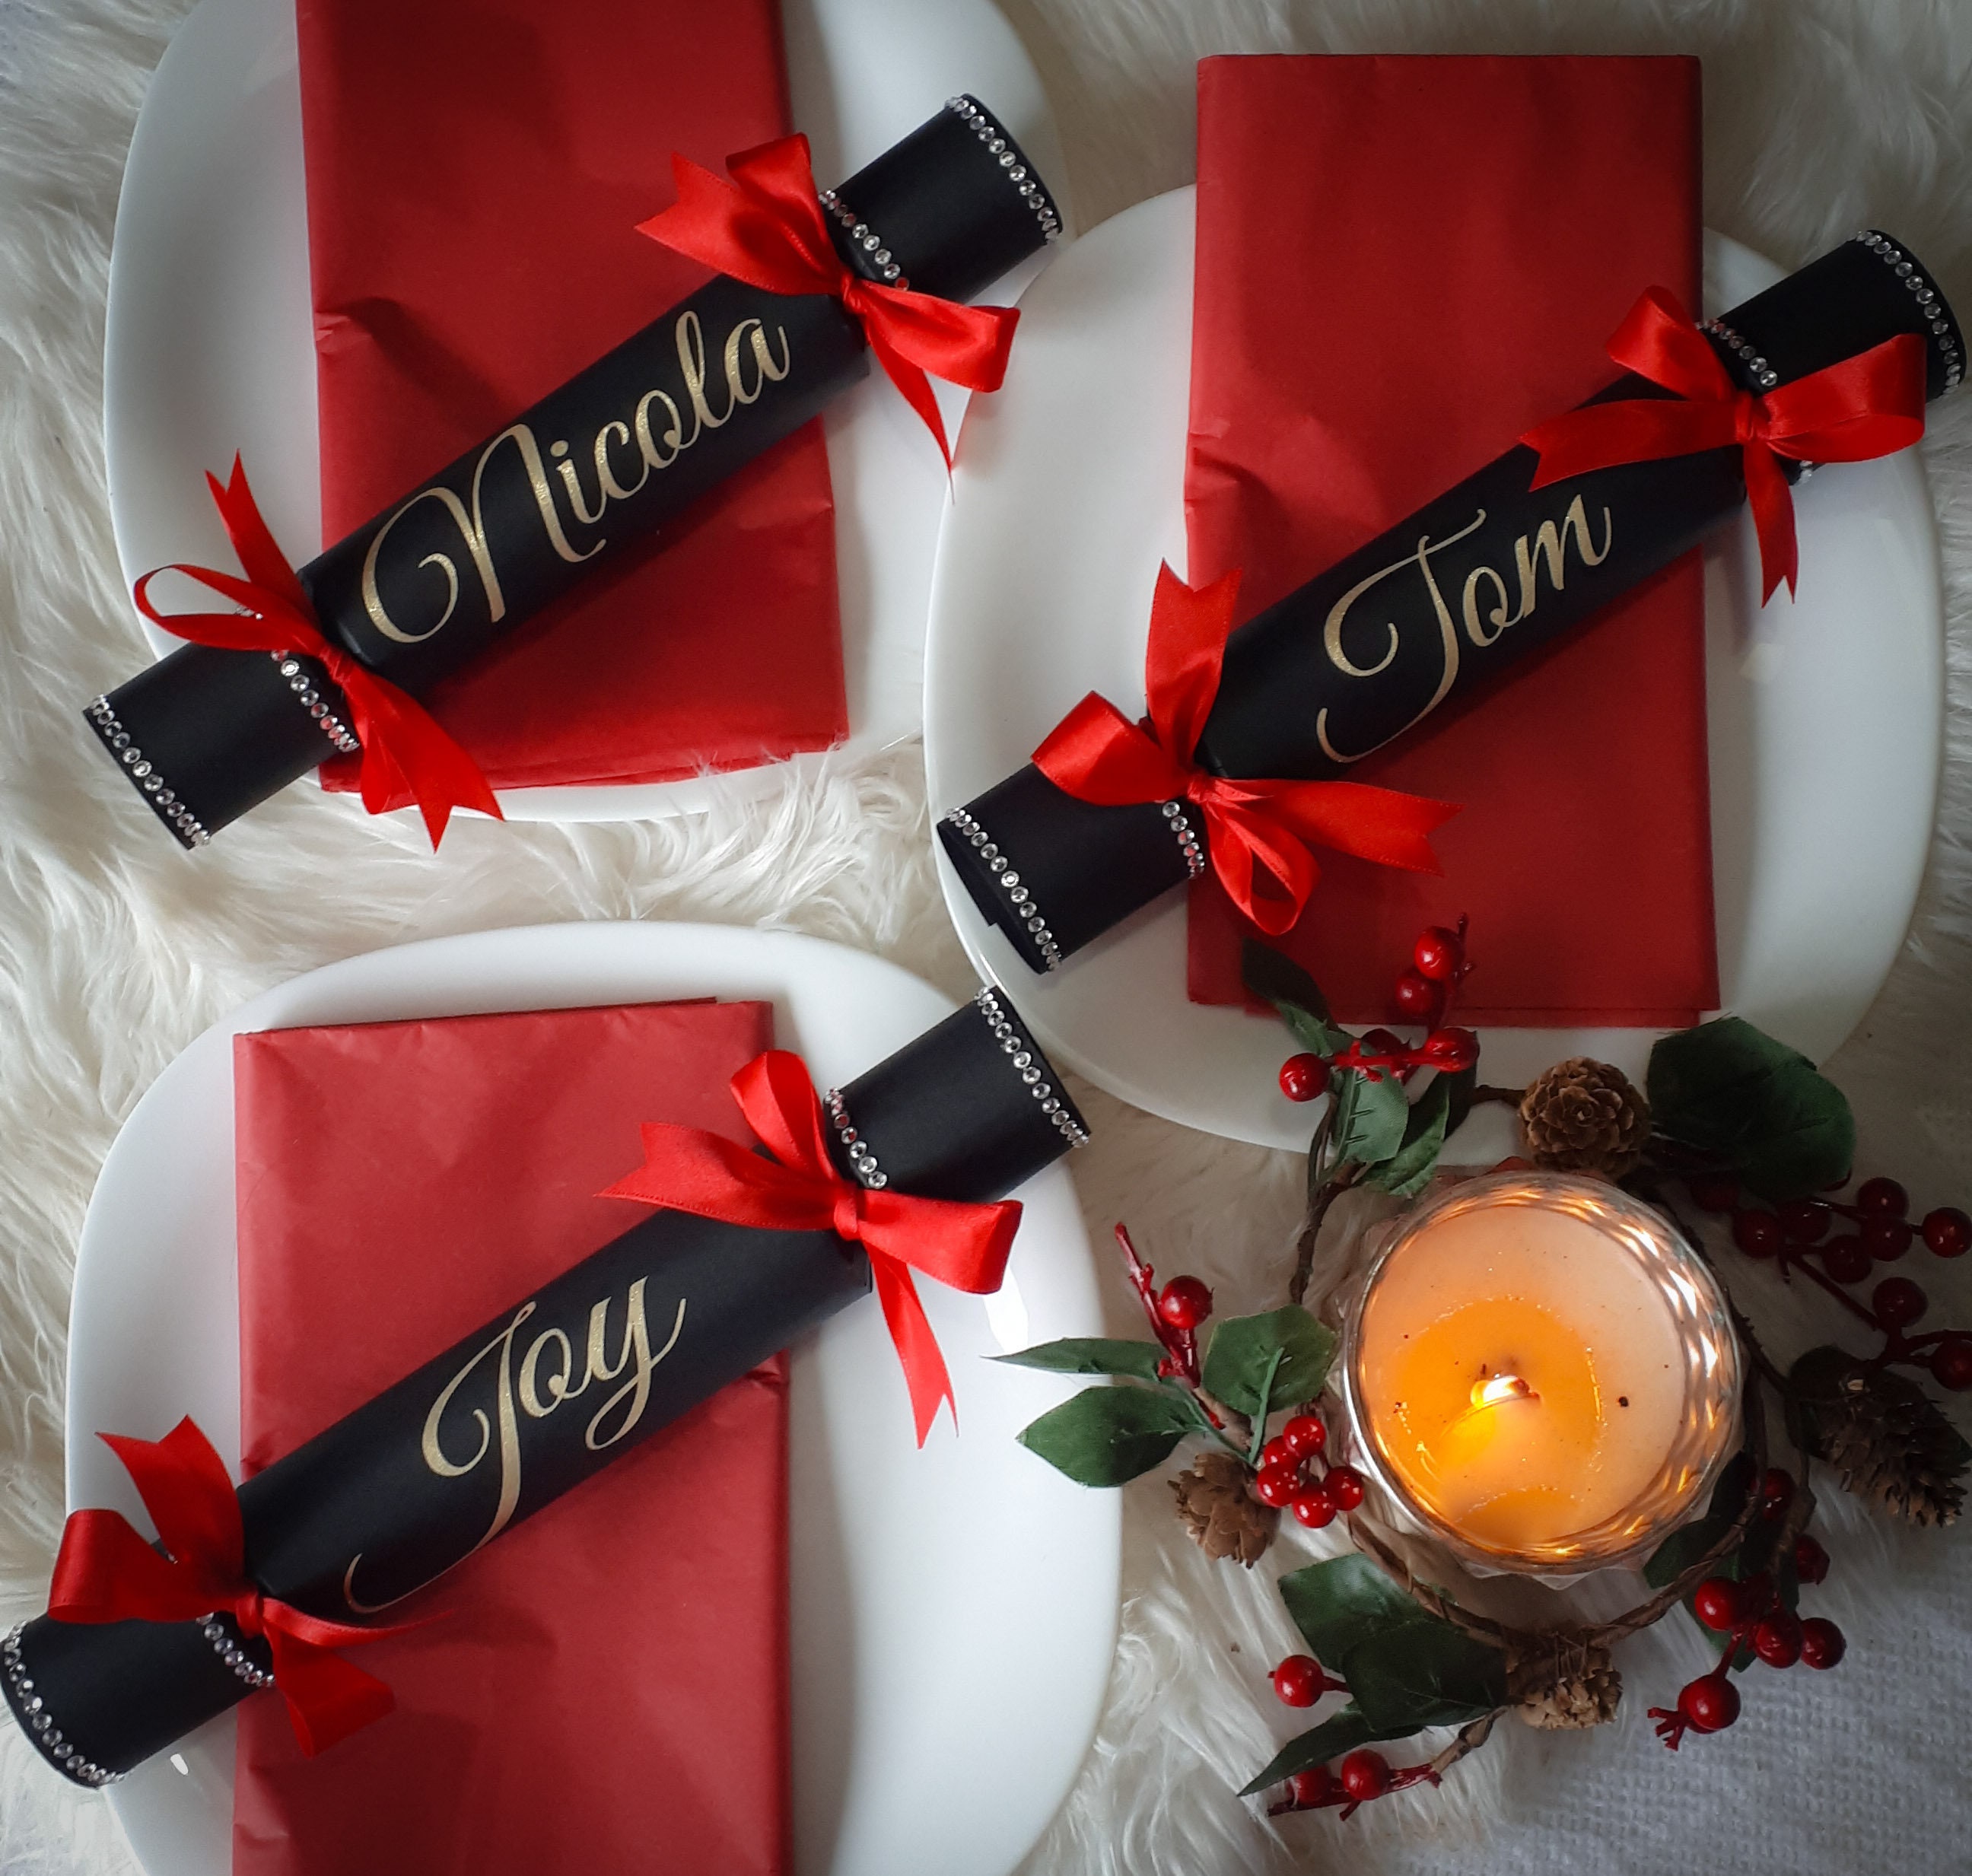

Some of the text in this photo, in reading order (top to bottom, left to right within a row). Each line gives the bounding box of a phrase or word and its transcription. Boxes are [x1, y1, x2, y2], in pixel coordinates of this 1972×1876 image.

[361, 310, 790, 644] Nicola
[1316, 494, 1612, 763] Tom
[343, 1275, 687, 1614] Joy
